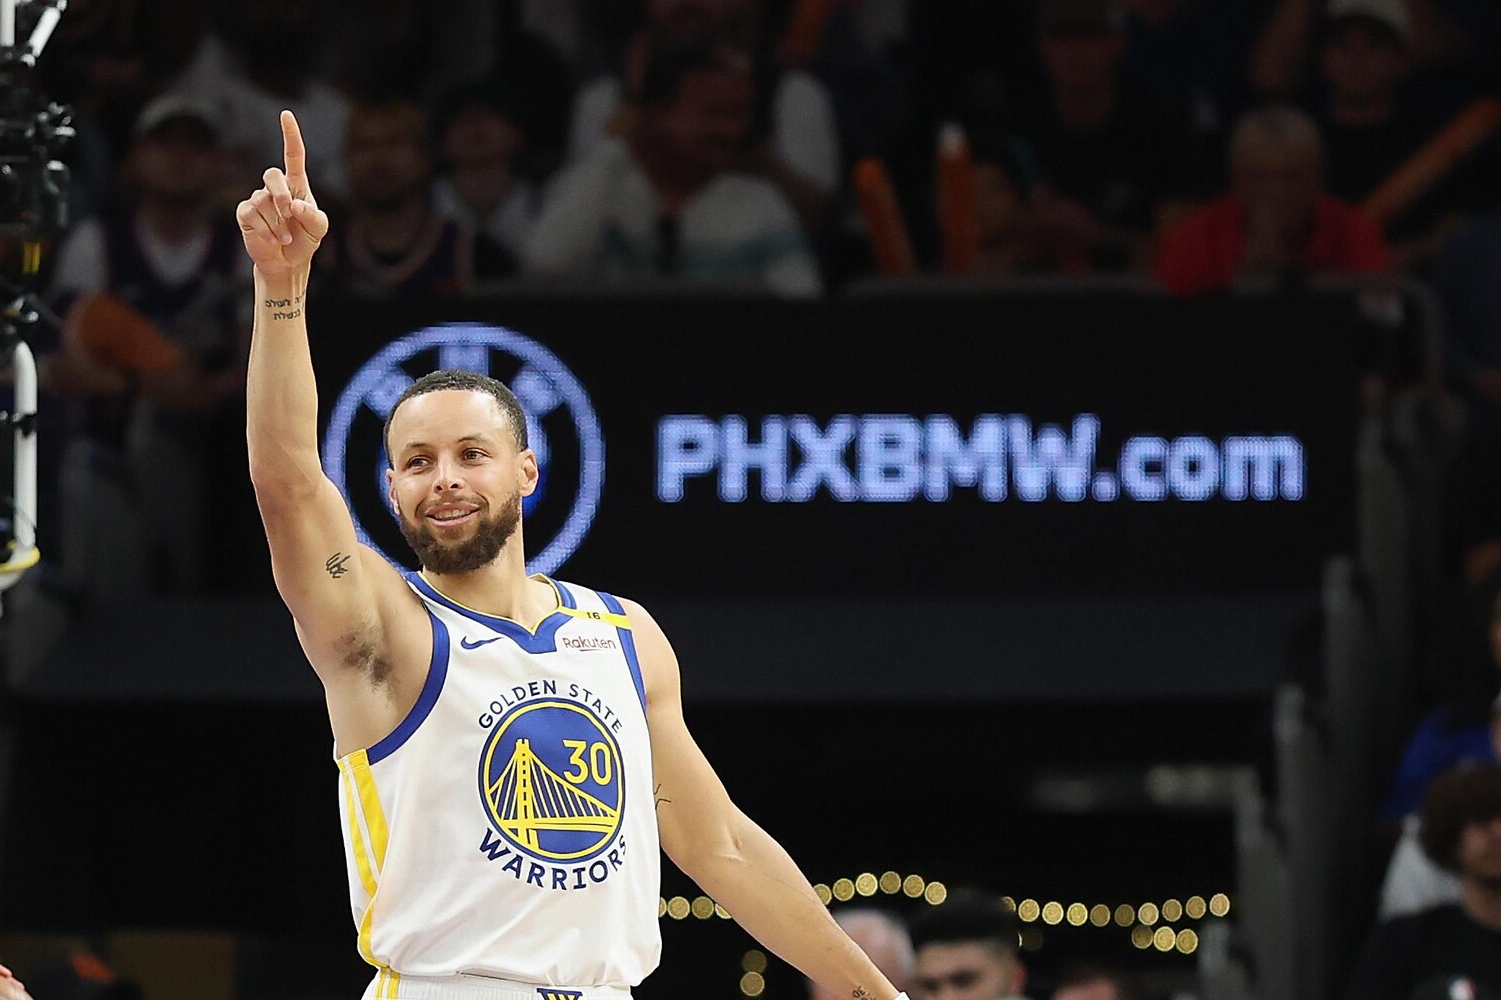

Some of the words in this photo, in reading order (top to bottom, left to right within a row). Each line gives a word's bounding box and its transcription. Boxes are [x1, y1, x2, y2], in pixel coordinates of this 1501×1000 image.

[655, 413, 1305, 501] PHXBMW.com
[562, 636, 617, 650] Rakuten
[478, 679, 557, 730] GOLDEN
[569, 683, 623, 734] STATE
[562, 739, 613, 786] 30
[479, 827, 627, 891] WARRIORS
